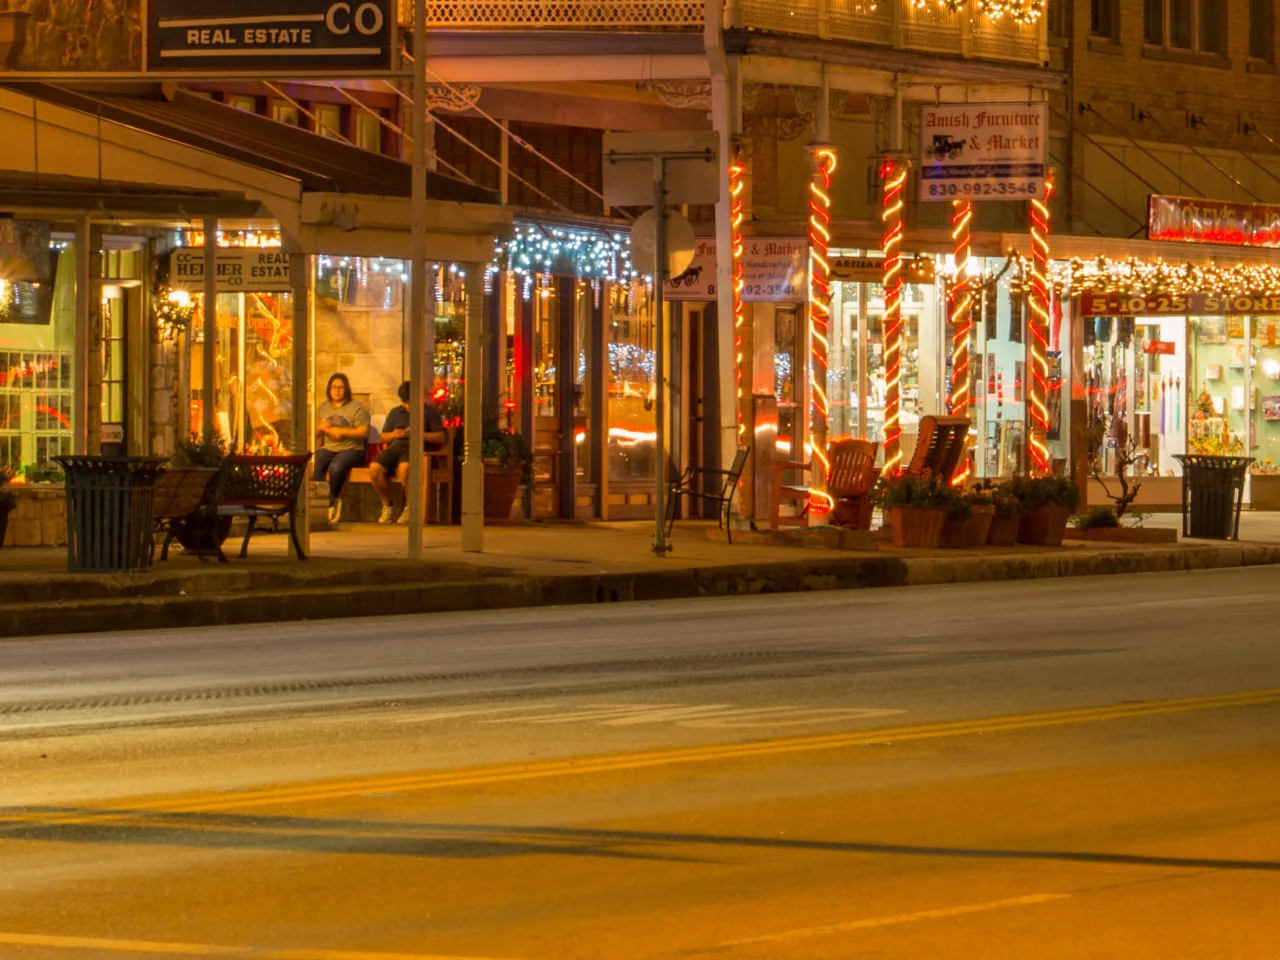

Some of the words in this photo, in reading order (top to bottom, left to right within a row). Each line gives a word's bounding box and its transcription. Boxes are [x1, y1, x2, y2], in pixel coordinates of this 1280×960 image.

[325, 2, 384, 35] CO
[187, 29, 237, 44] REAL
[244, 28, 312, 44] ESTATE
[925, 111, 969, 129] Amish
[972, 111, 1040, 129] Furniture
[969, 135, 981, 150] &
[986, 134, 1040, 151] Market
[929, 182, 1037, 196] 830-992-3546
[177, 253, 192, 263] CC
[258, 254, 289, 263] REAL
[177, 264, 242, 275] HEER
[251, 266, 290, 277] ESTAT
[227, 277, 243, 286] CO
